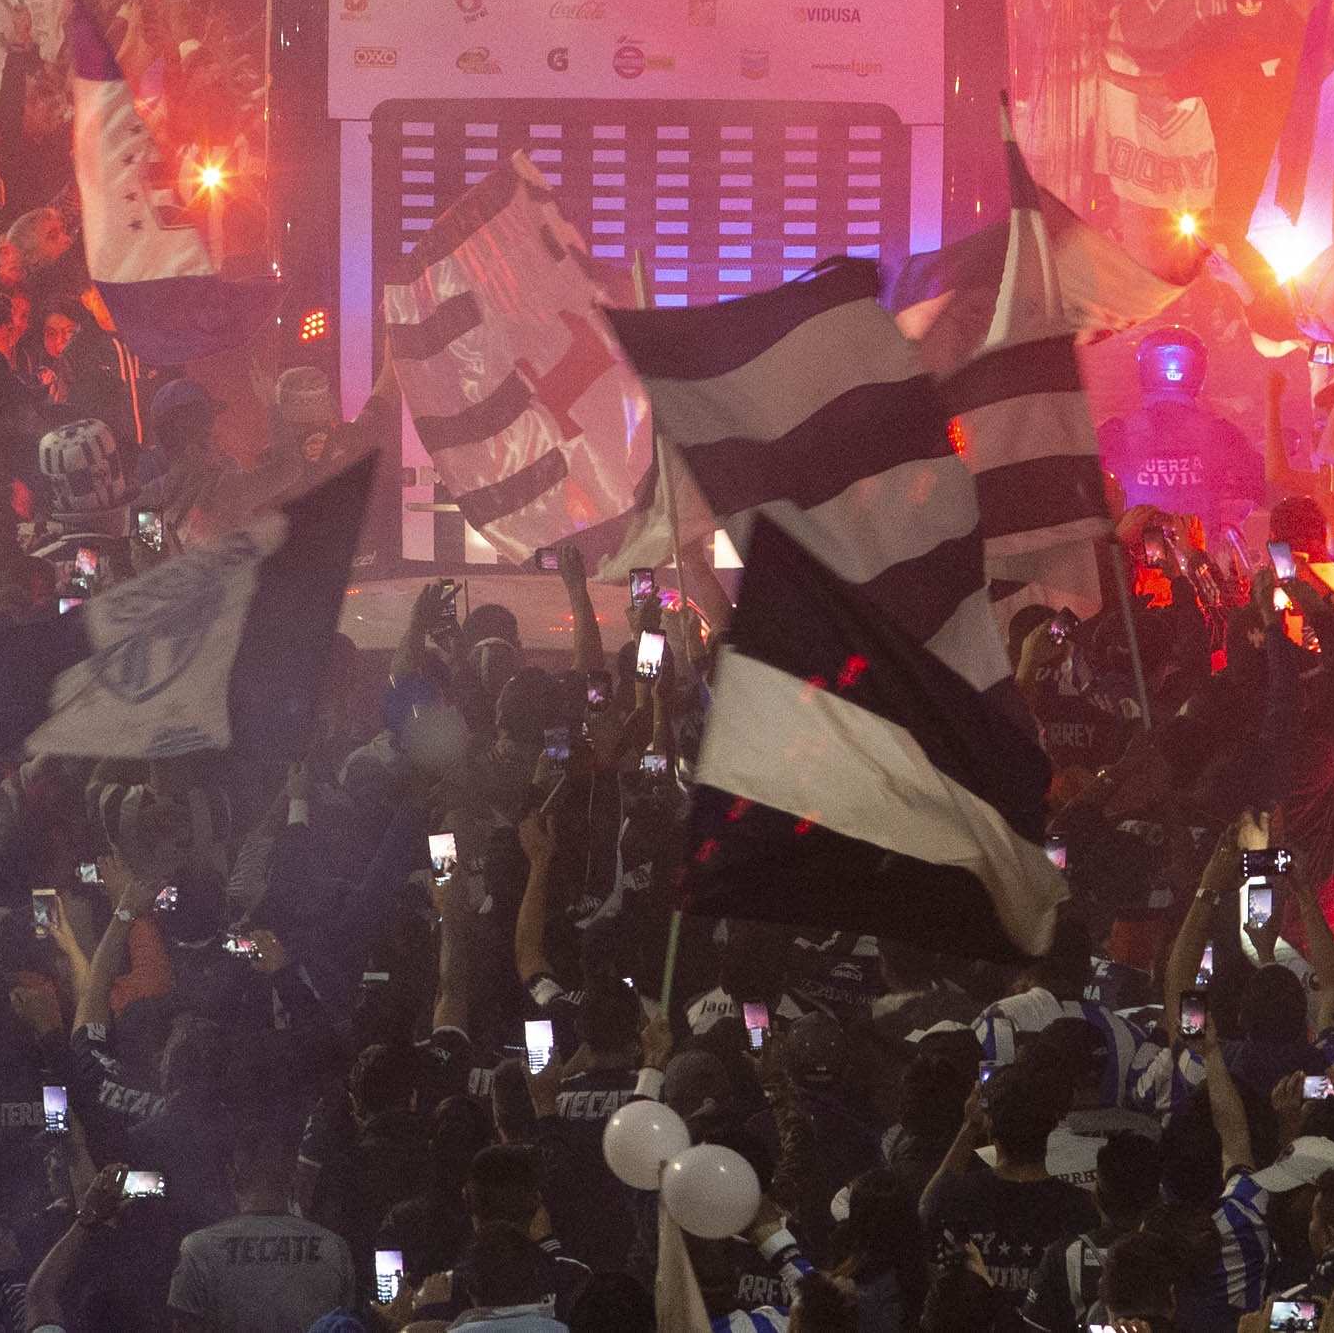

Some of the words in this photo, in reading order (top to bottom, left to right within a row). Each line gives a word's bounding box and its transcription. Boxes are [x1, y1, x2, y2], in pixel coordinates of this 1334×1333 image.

[807, 7, 861, 22] VIDUSA
[355, 51, 396, 64] OXXO
[1139, 456, 1204, 473] UERZA
[1137, 472, 1202, 487] CIVIL
[556, 1090, 637, 1119] TECAT
[226, 1236, 322, 1266] TECATE
